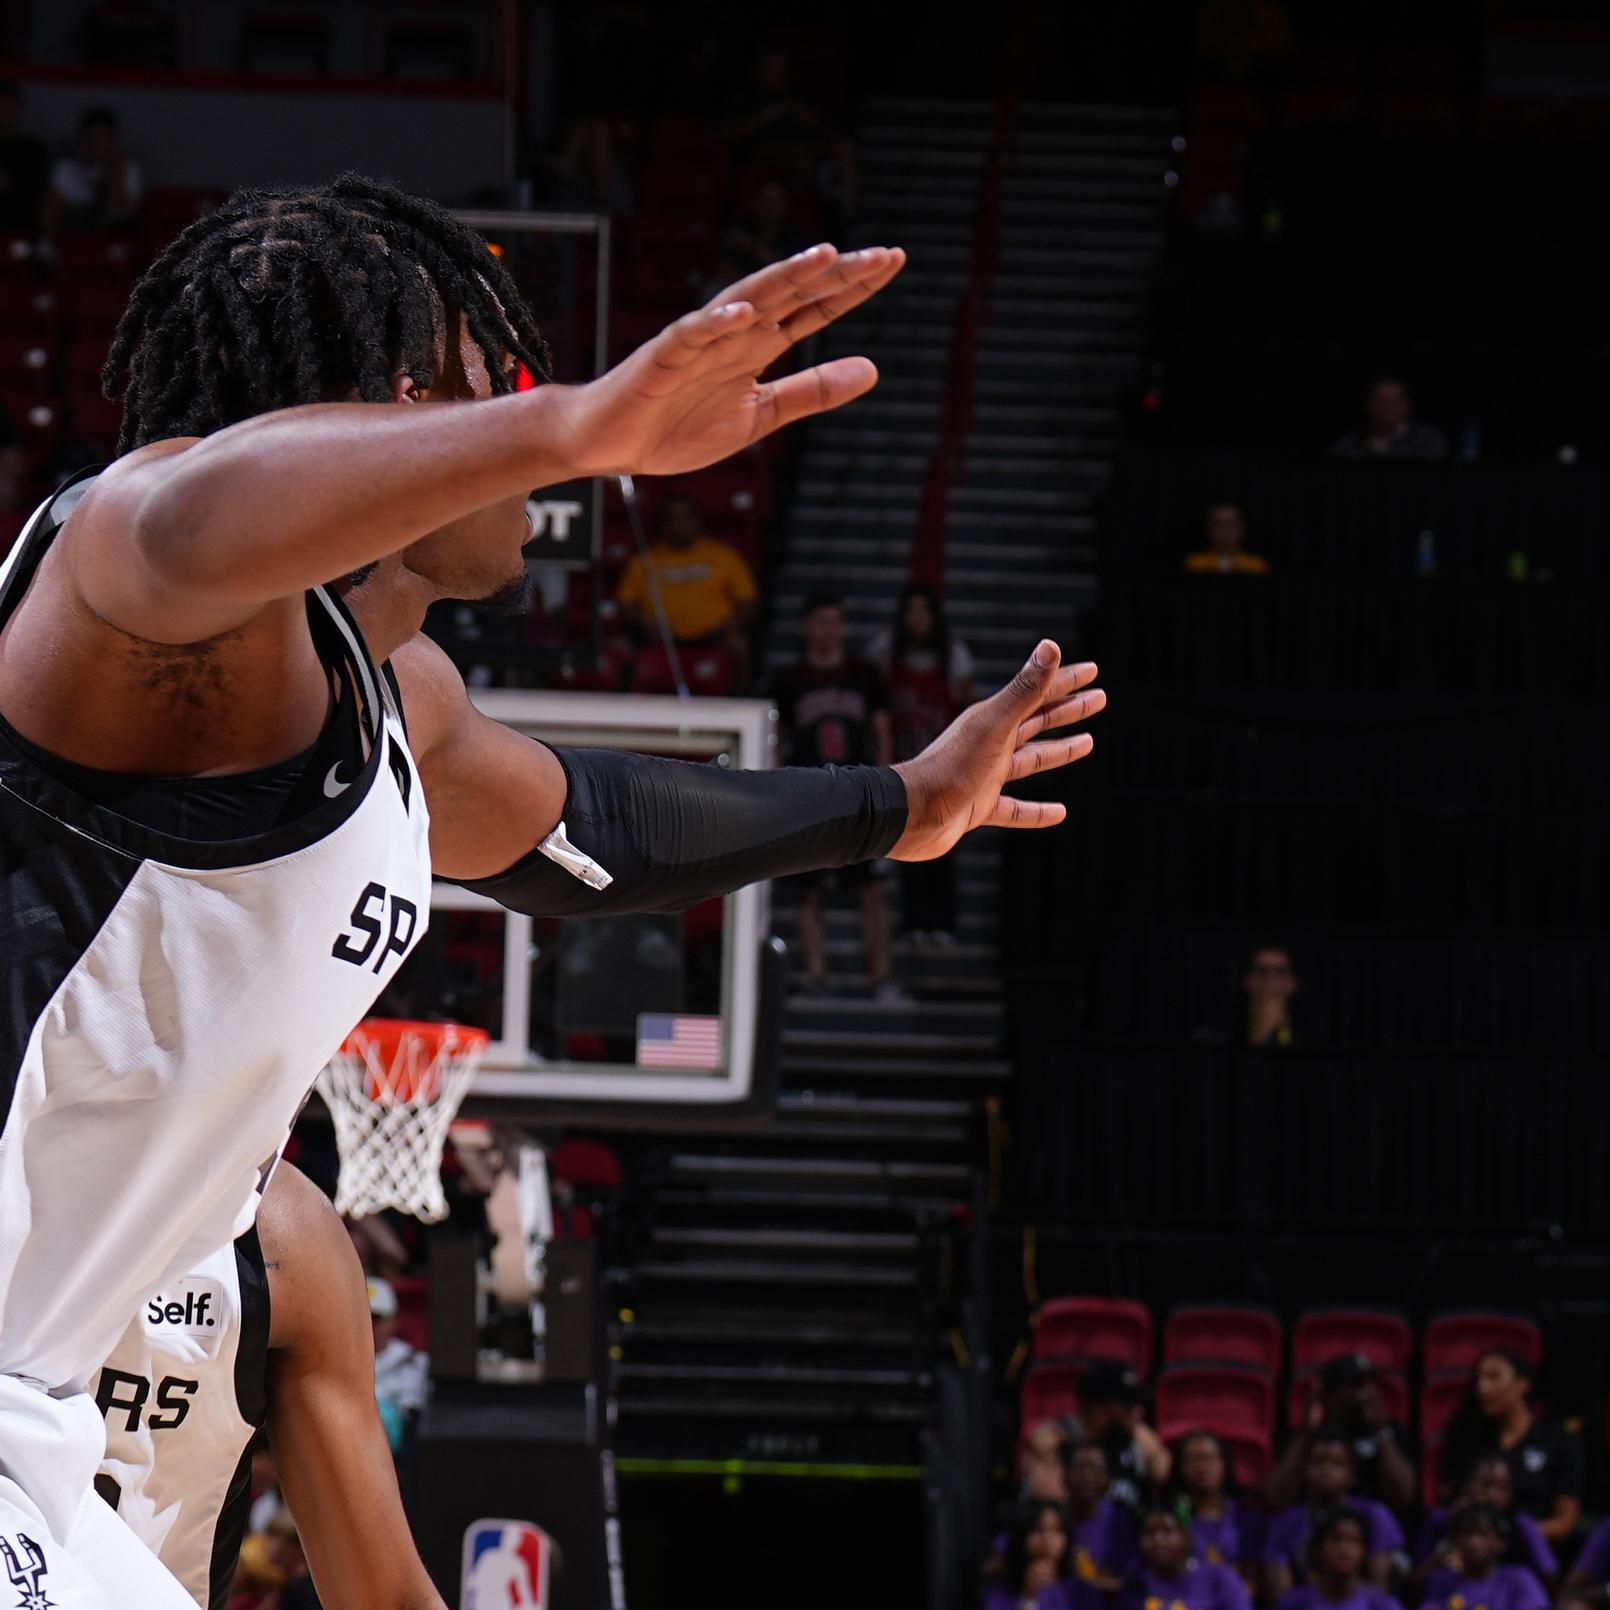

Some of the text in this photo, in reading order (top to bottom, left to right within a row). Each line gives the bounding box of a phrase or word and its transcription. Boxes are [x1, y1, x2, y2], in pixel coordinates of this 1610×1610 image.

[332, 881, 417, 975] SP
[147, 1291, 215, 1327] Self.
[95, 1366, 199, 1432] RS
